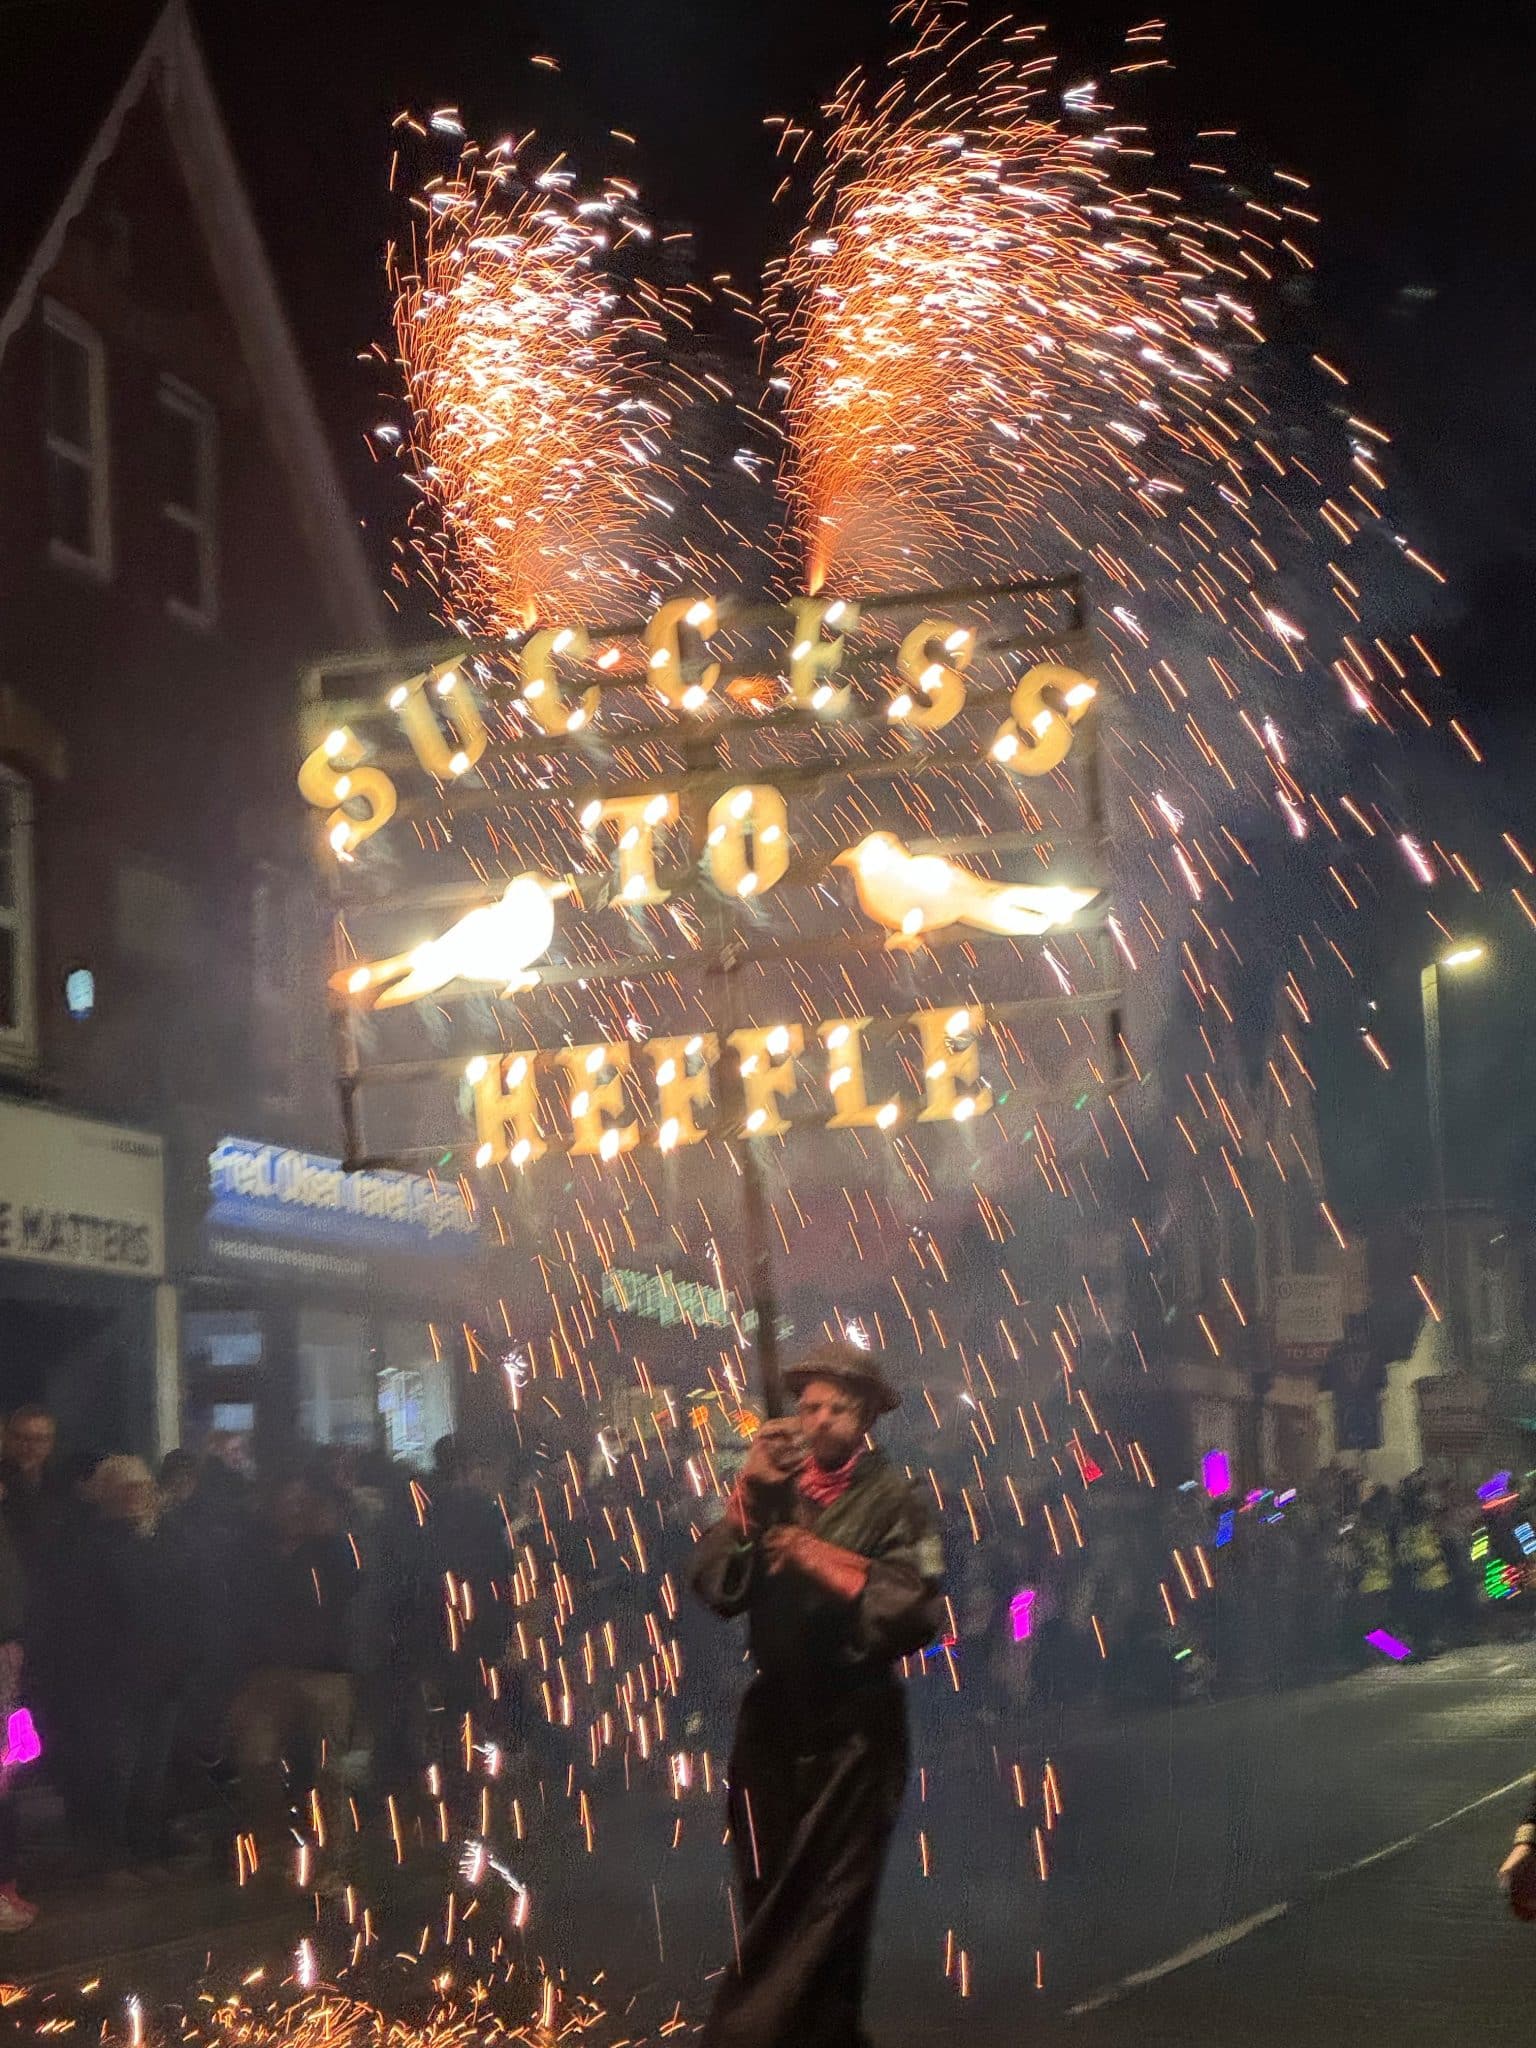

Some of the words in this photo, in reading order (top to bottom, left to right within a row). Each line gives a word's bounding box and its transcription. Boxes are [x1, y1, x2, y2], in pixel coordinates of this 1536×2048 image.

[298, 596, 1099, 859] SUCCESS
[581, 784, 790, 906] TO
[465, 1004, 993, 1168] HEFFLE
